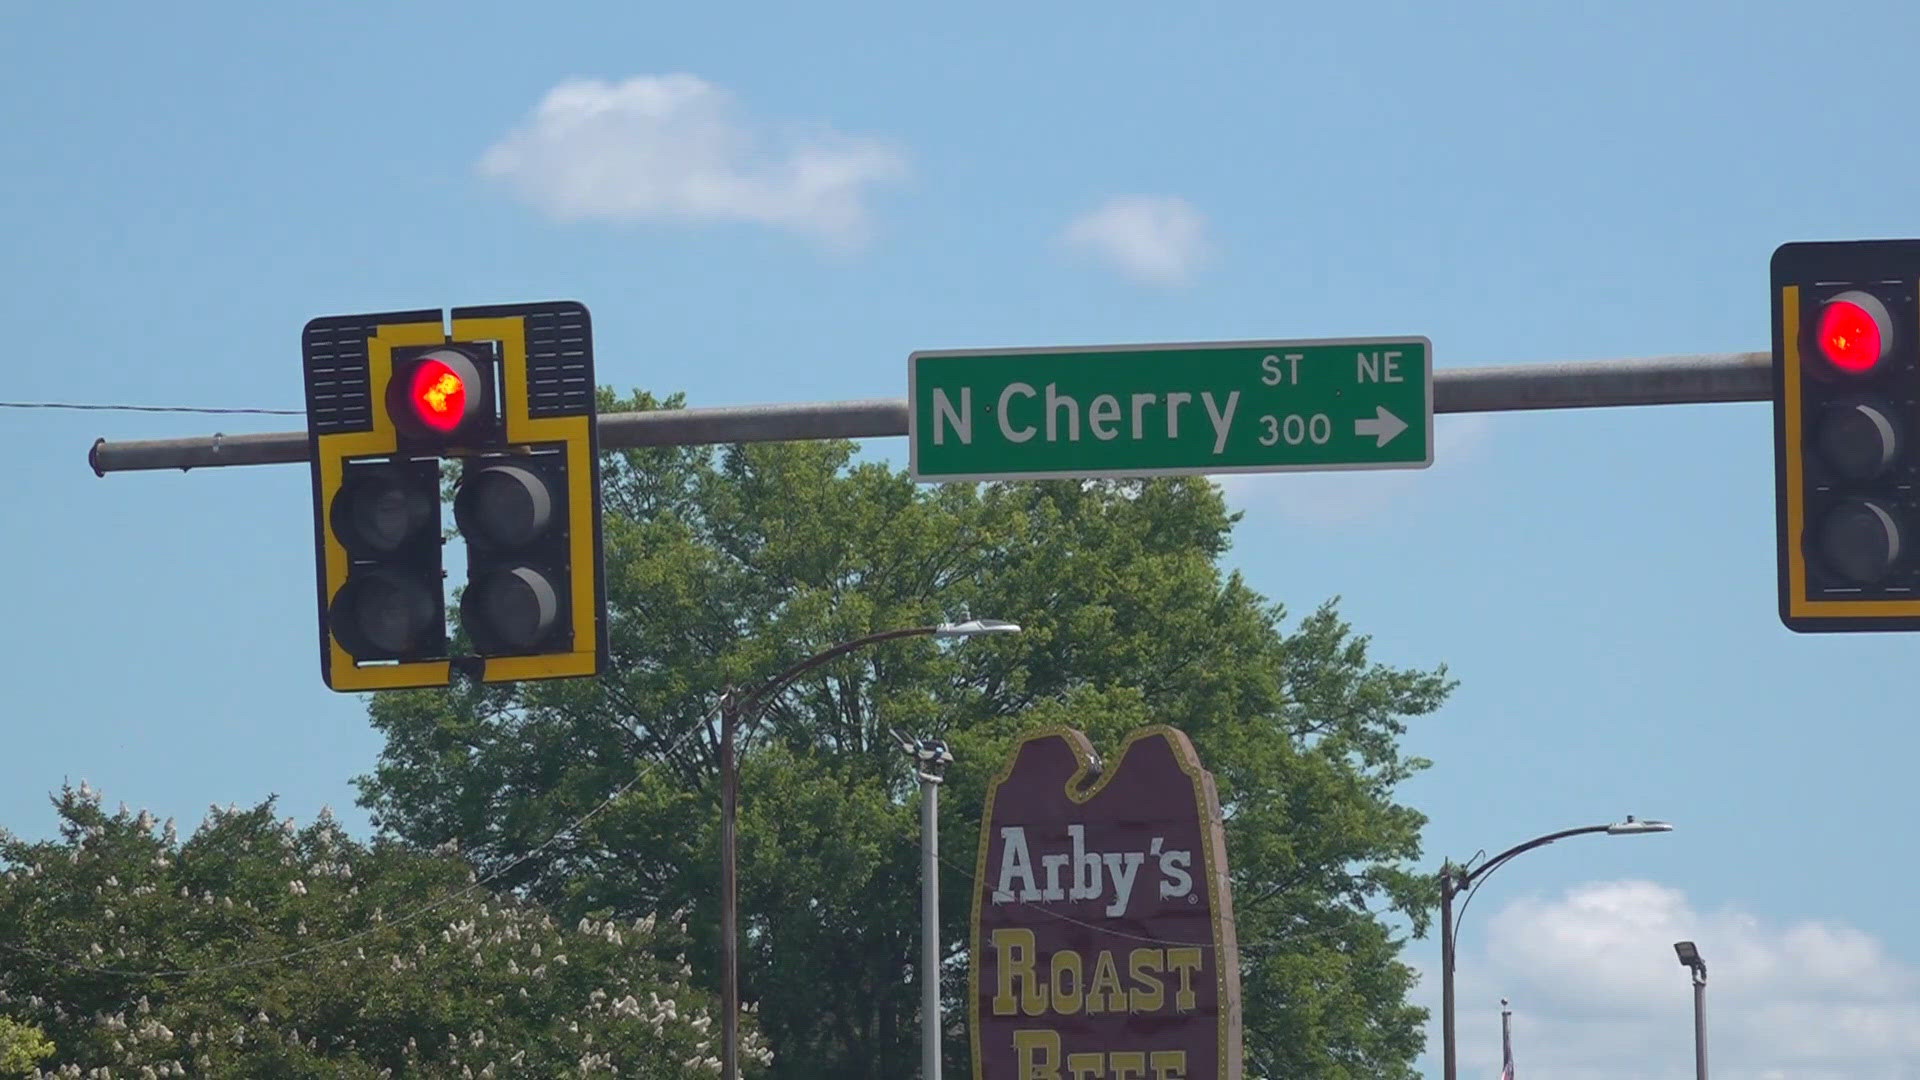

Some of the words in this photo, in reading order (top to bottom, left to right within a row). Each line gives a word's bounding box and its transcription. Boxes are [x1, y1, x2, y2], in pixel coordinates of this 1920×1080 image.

[1261, 354, 1304, 386] ST
[1357, 351, 1404, 383] NE
[933, 386, 972, 445] N
[997, 381, 1240, 454] Cherry
[1258, 413, 1330, 446] 300
[992, 824, 1193, 917] Arby's
[992, 928, 1203, 1016] ROAST
